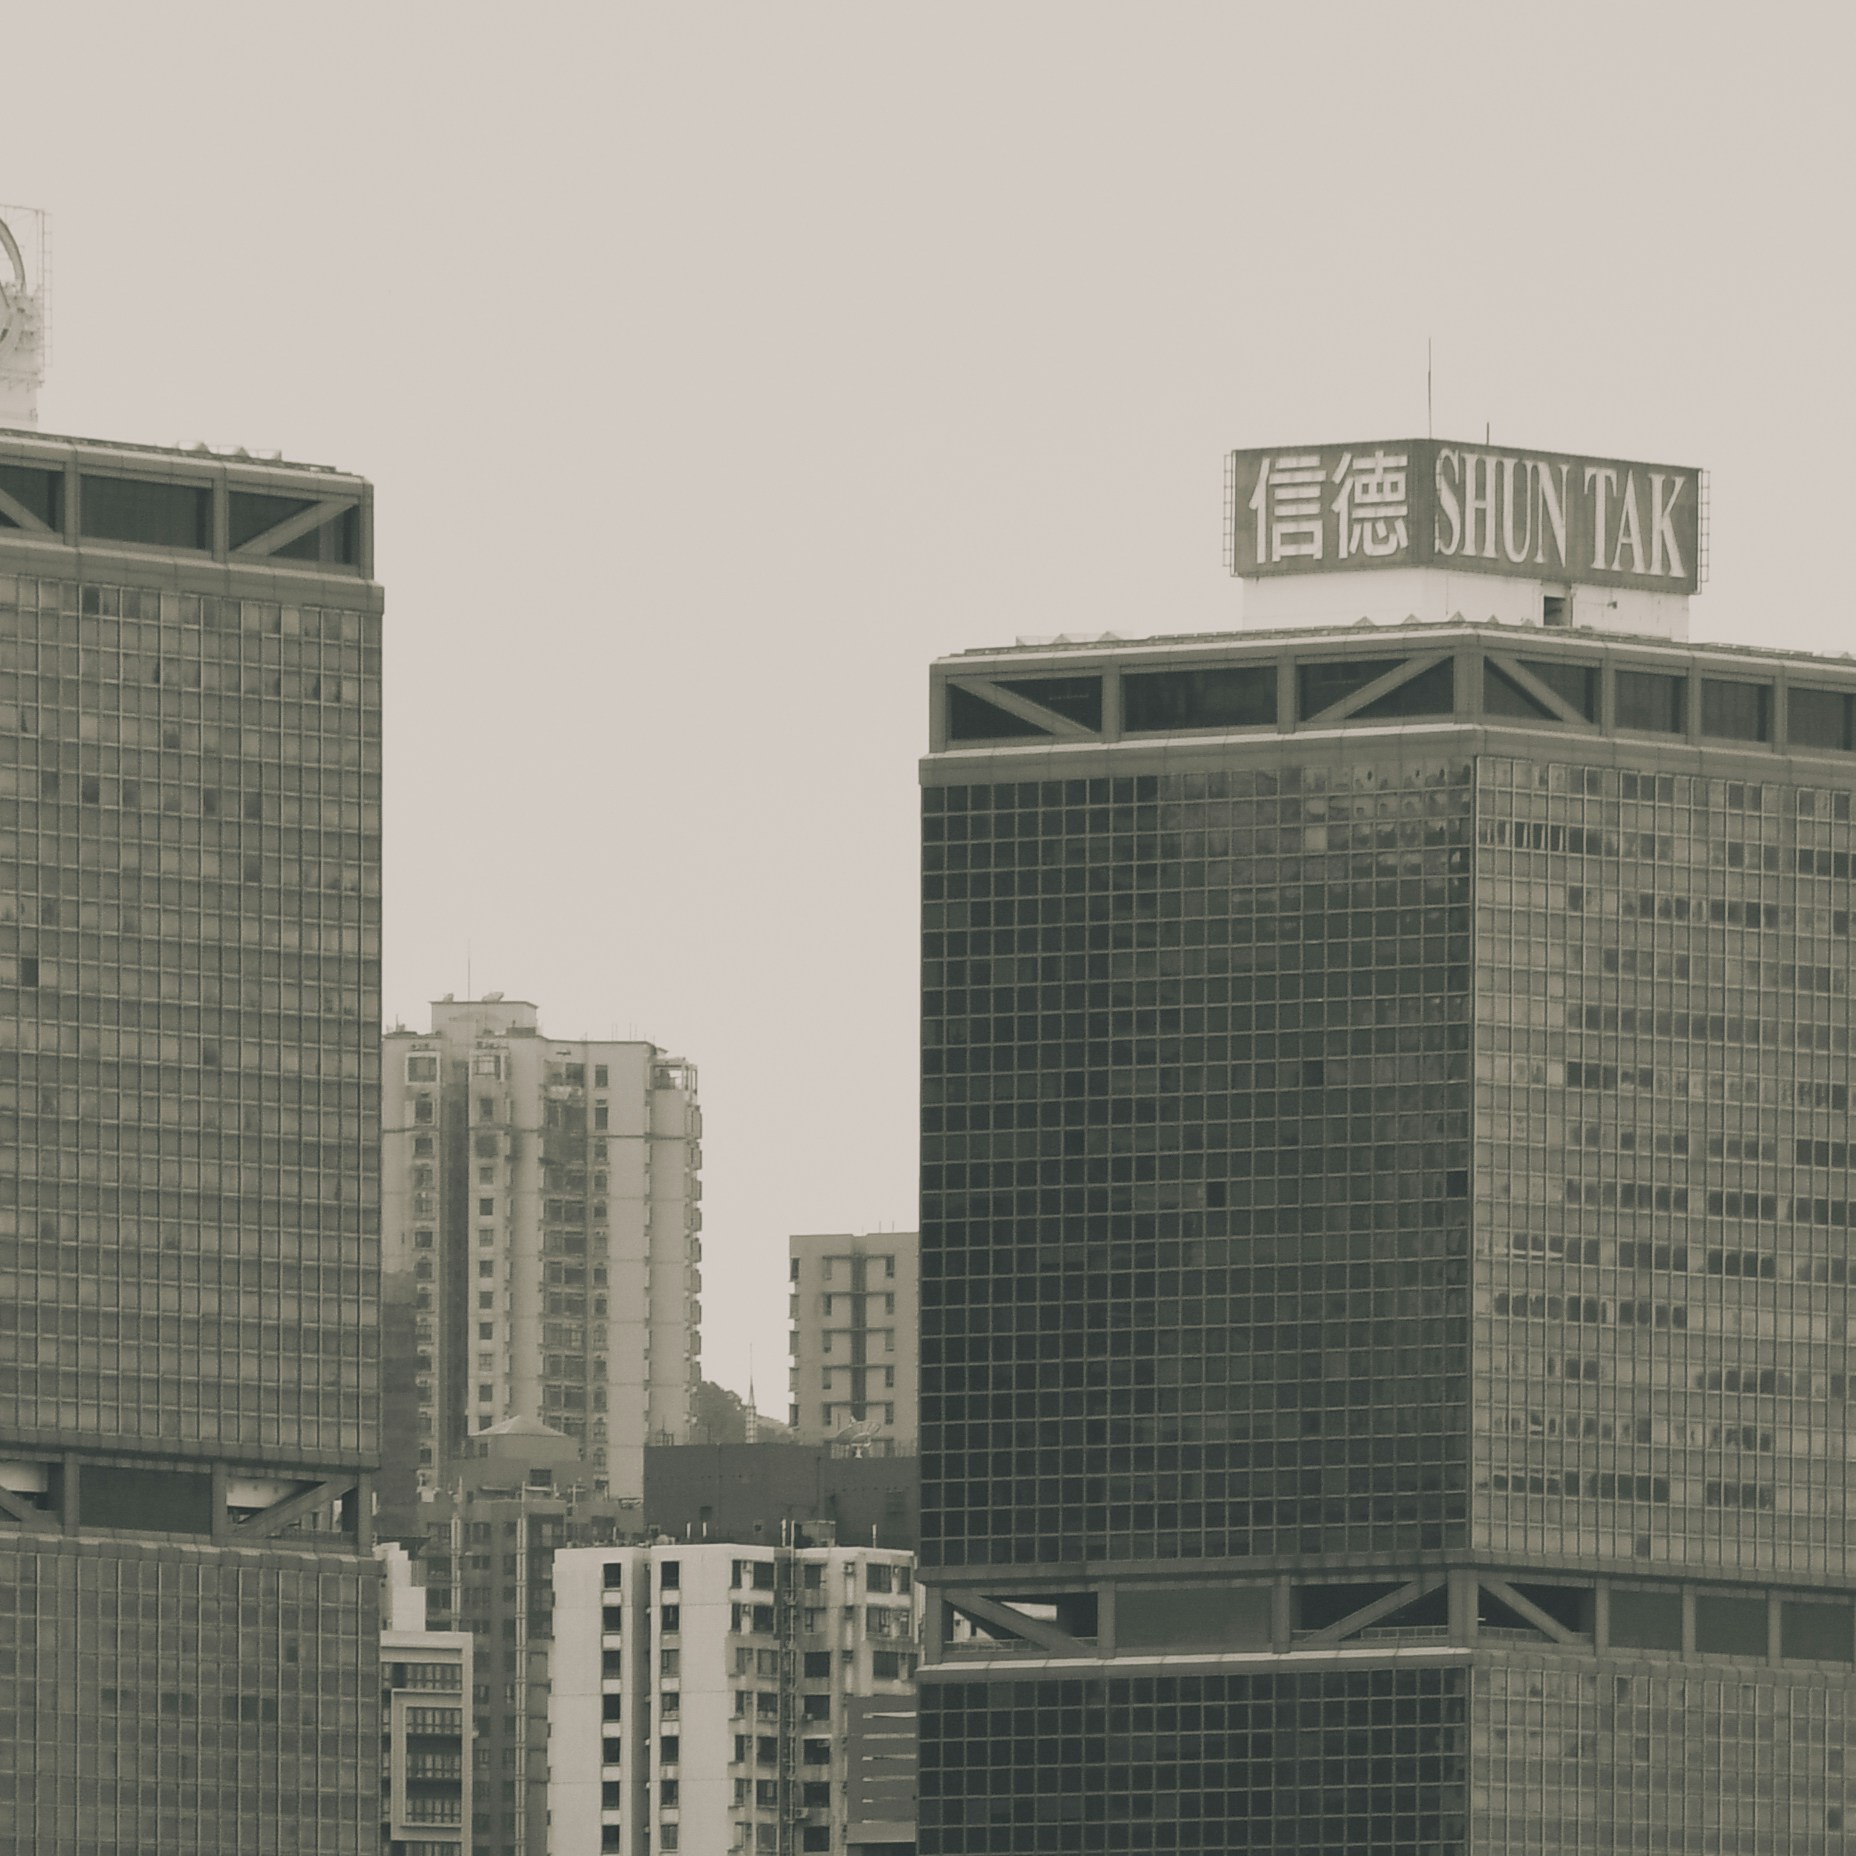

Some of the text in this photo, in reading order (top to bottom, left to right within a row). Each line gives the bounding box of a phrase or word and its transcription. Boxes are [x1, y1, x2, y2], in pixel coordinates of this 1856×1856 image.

[1248, 450, 1409, 565] 信德
[1434, 448, 1687, 579] SHUN TAK
